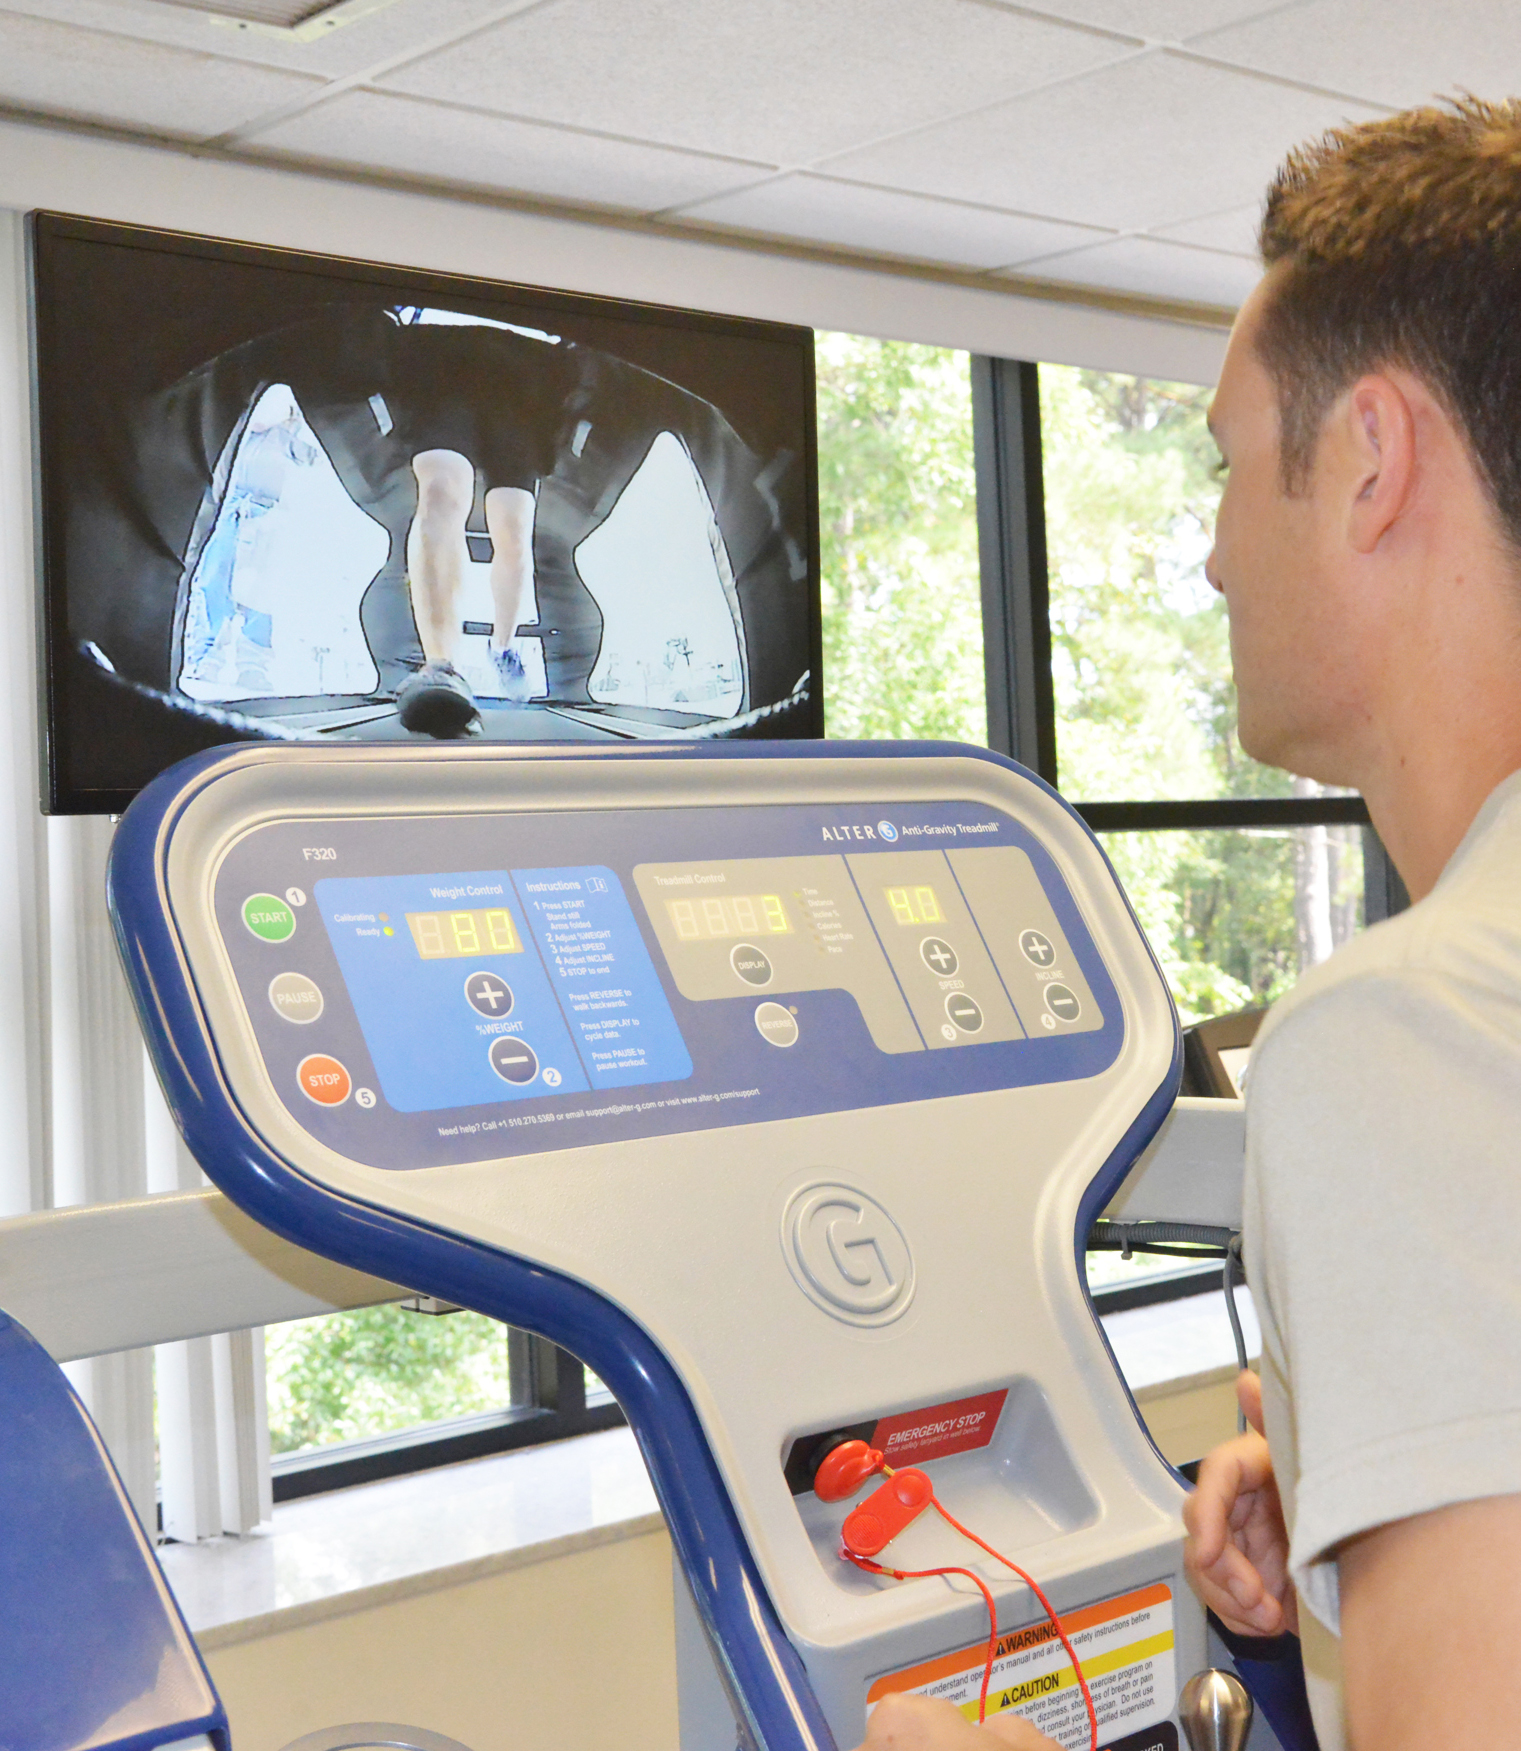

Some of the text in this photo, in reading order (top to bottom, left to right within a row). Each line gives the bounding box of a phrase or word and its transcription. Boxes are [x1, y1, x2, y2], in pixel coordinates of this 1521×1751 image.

[902, 824, 956, 836] Anti-Gravity
[302, 848, 337, 861] F320
[526, 880, 581, 892] Instructions
[654, 873, 726, 886] Treadmill Control
[430, 884, 503, 900] Weight Control
[534, 900, 585, 910] 1 Press START
[251, 911, 288, 924] START
[334, 913, 375, 923] Calibrating
[546, 911, 580, 921] Stand still
[450, 910, 515, 953] 80
[570, 921, 591, 929] folded
[356, 927, 380, 937] Ready
[545, 930, 611, 943] 2 Adjust %WEIGHT
[550, 942, 606, 954] 3 Adjust SPEED
[555, 953, 615, 966] 4 Adjust INCLINE
[738, 961, 766, 970] DISPLAY
[559, 966, 610, 977] 5 STOP to end
[1035, 970, 1065, 981] INCLINE
[938, 979, 965, 990] SPEED
[277, 991, 317, 1005] PAUSE
[568, 989, 632, 1001] Press REVERSE to
[573, 1000, 629, 1011] walk backwards.
[476, 1021, 524, 1036] %WEIGHT
[580, 1022, 600, 1031] Press
[600, 1019, 631, 1029] DISPLAY
[761, 1019, 793, 1030] REVERSE
[584, 1032, 603, 1042] cycle
[591, 1052, 612, 1060] Press
[612, 1048, 637, 1058] PAUSE
[596, 1058, 648, 1072] pause workout.
[309, 1073, 341, 1087] STOP
[438, 1126, 459, 1137] Need
[459, 1123, 481, 1135] help?
[482, 1120, 497, 1131] Call
[498, 1119, 507, 1128] +1
[556, 1113, 564, 1121] or
[565, 1109, 585, 1120] email
[665, 1097, 681, 1107] visit
[887, 1411, 986, 1446] EMERGENCY STOP
[900, 1440, 919, 1451] safety
[1005, 1622, 1059, 1652] WARNING
[929, 1674, 969, 1696] understand
[1006, 1653, 1031, 1670] manual
[1032, 1649, 1044, 1660] and
[1046, 1645, 1054, 1655] all
[1073, 1633, 1093, 1646] safety
[1094, 1619, 1130, 1639] instructions
[1131, 1612, 1151, 1626] before
[1011, 1673, 1059, 1703] CAUTION
[1025, 1700, 1046, 1715] before
[1047, 1688, 1079, 1706] beginning
[1090, 1674, 1117, 1690] exercise
[1117, 1663, 1144, 1680] program
[1145, 1661, 1153, 1670] on
[1037, 1705, 1069, 1723] dizziness,
[1103, 1687, 1110, 1698] of
[1111, 1680, 1131, 1695] breath
[1132, 1679, 1139, 1687] or
[1140, 1673, 1154, 1686] pain
[1047, 1716, 1070, 1733] consult
[1071, 1711, 1086, 1725] your
[1121, 1693, 1130, 1704] Do
[1131, 1690, 1141, 1701] not
[1143, 1685, 1154, 1695] use
[1058, 1725, 1082, 1741] training
[1094, 1710, 1118, 1727] ualified
[1119, 1697, 1155, 1717] supervision.
